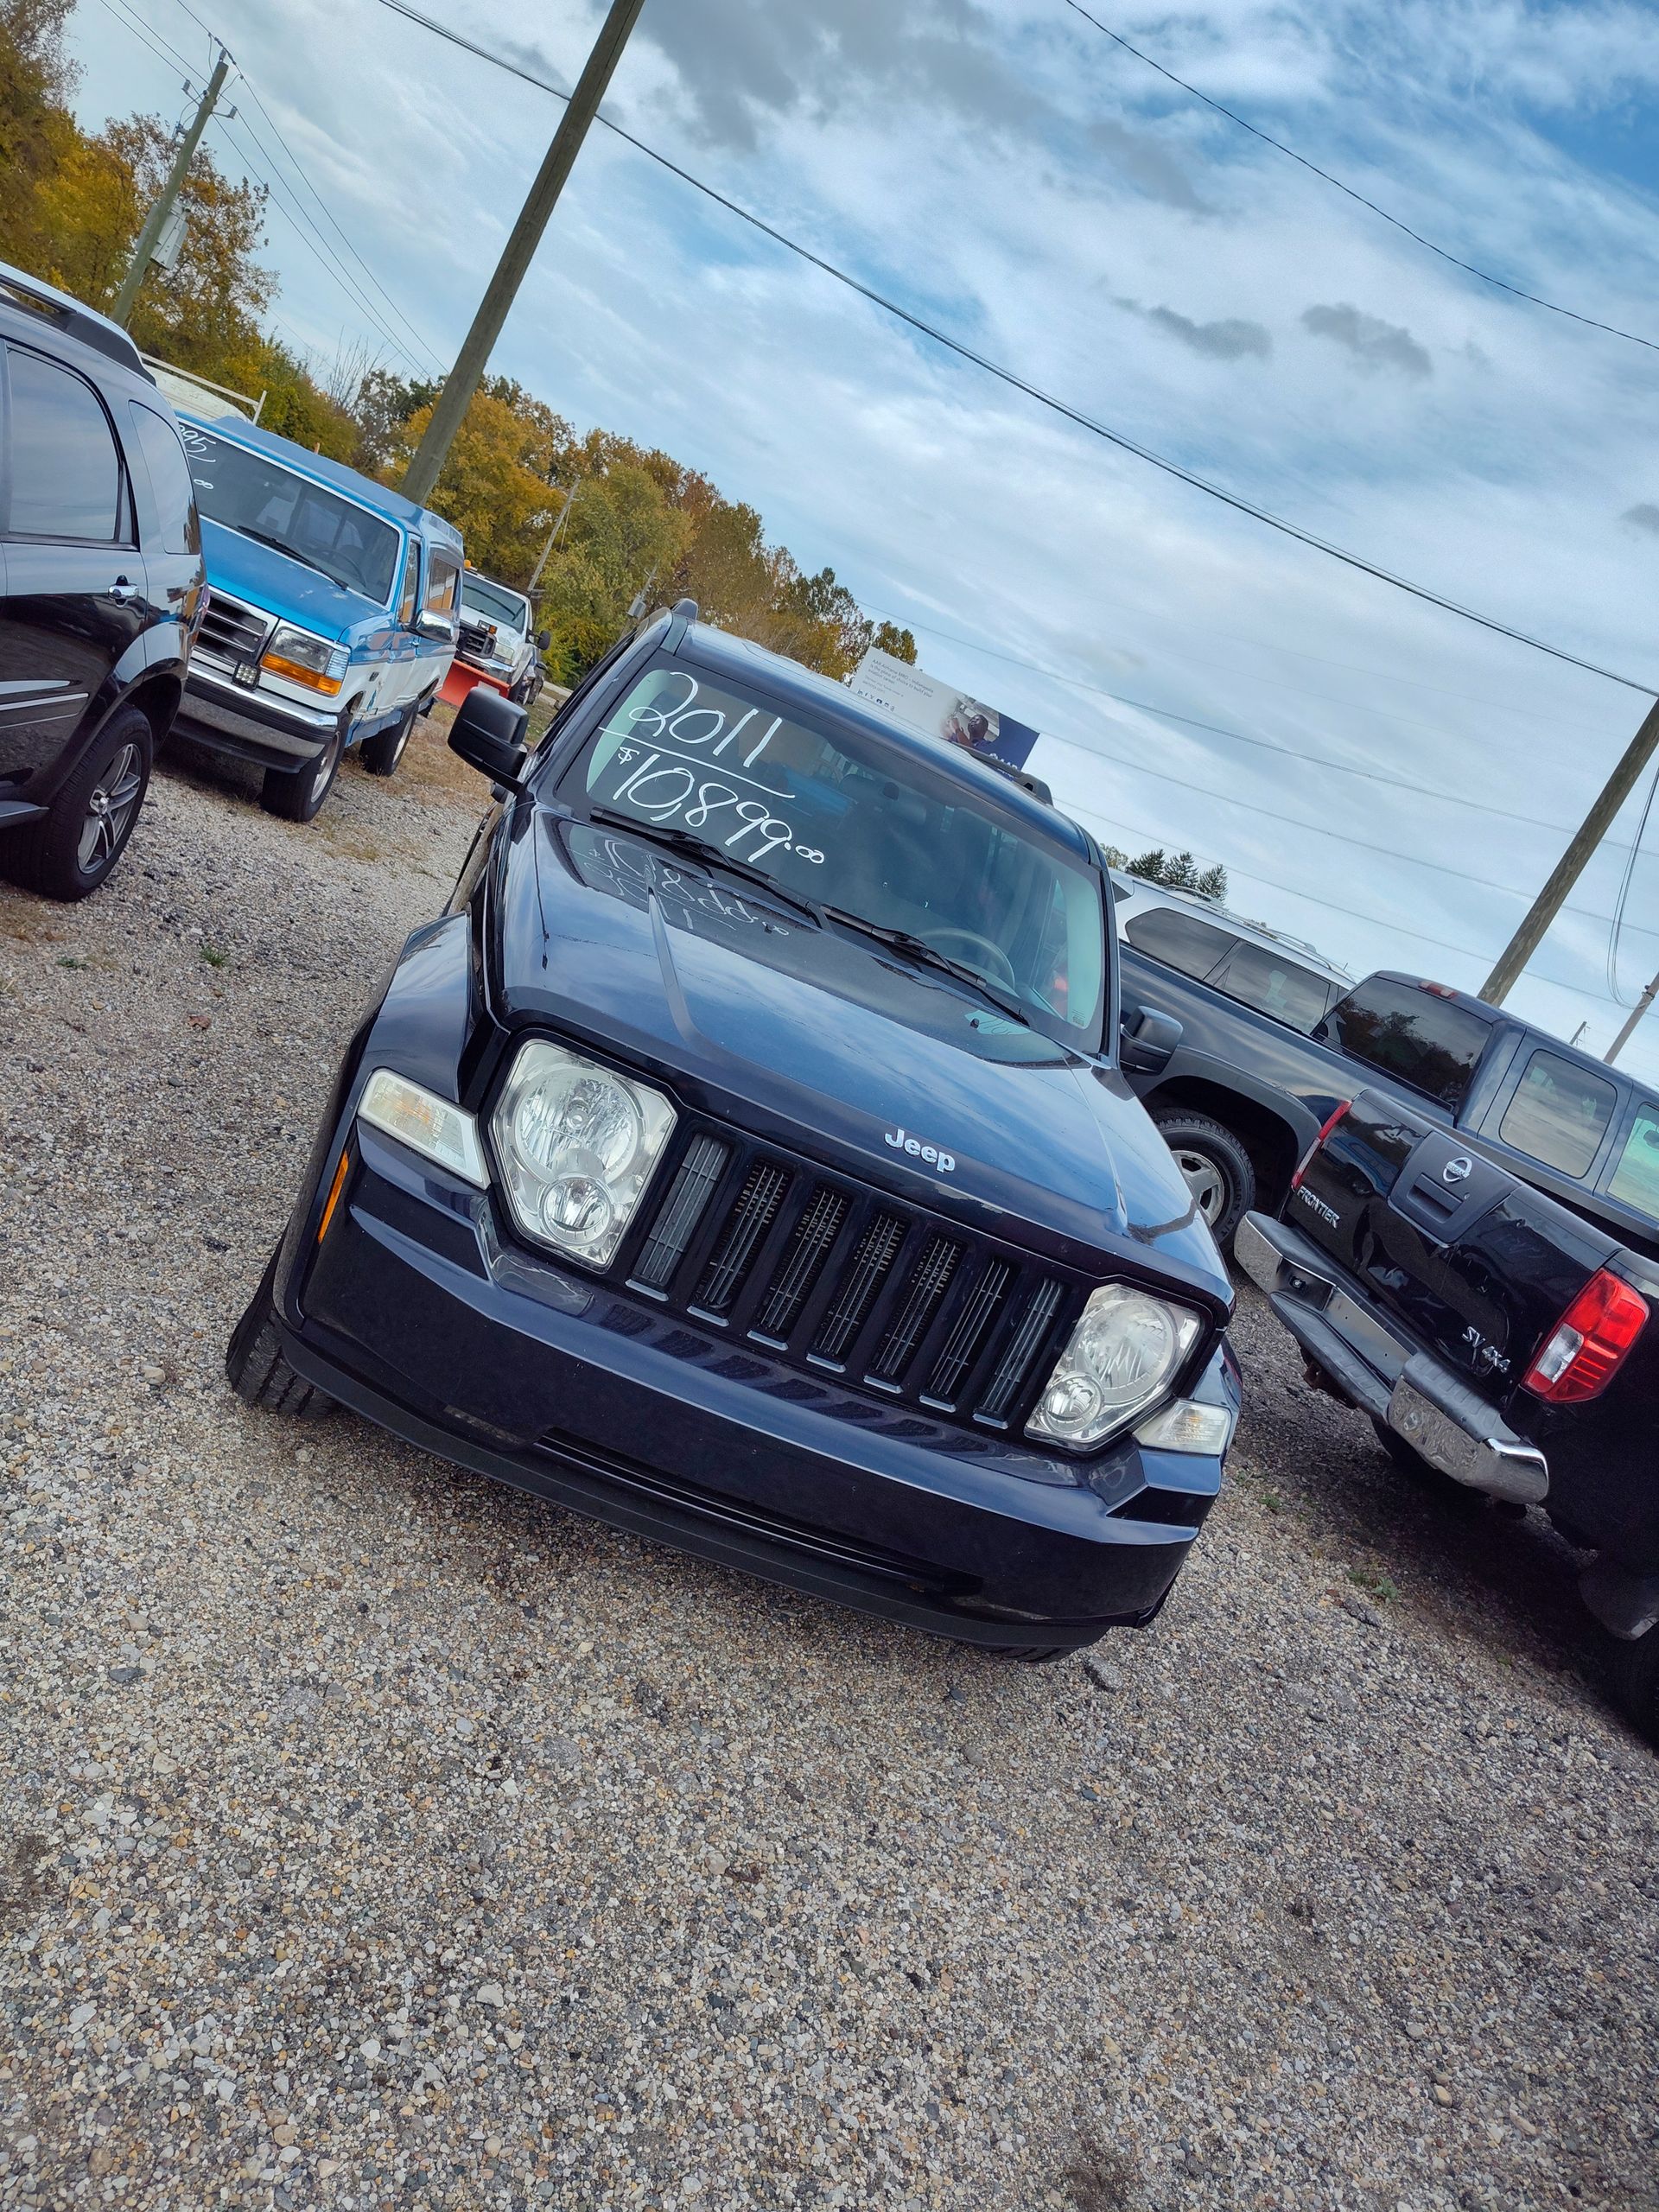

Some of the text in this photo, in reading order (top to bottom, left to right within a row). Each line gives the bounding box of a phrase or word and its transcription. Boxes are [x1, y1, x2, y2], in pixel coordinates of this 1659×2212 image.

[180, 424, 217, 453] 95
[628, 671, 783, 768] 2011
[884, 1128, 956, 1173] Jeep
[1297, 1185, 1341, 1230] FRONTIER
[1461, 1325, 1486, 1347] SV
